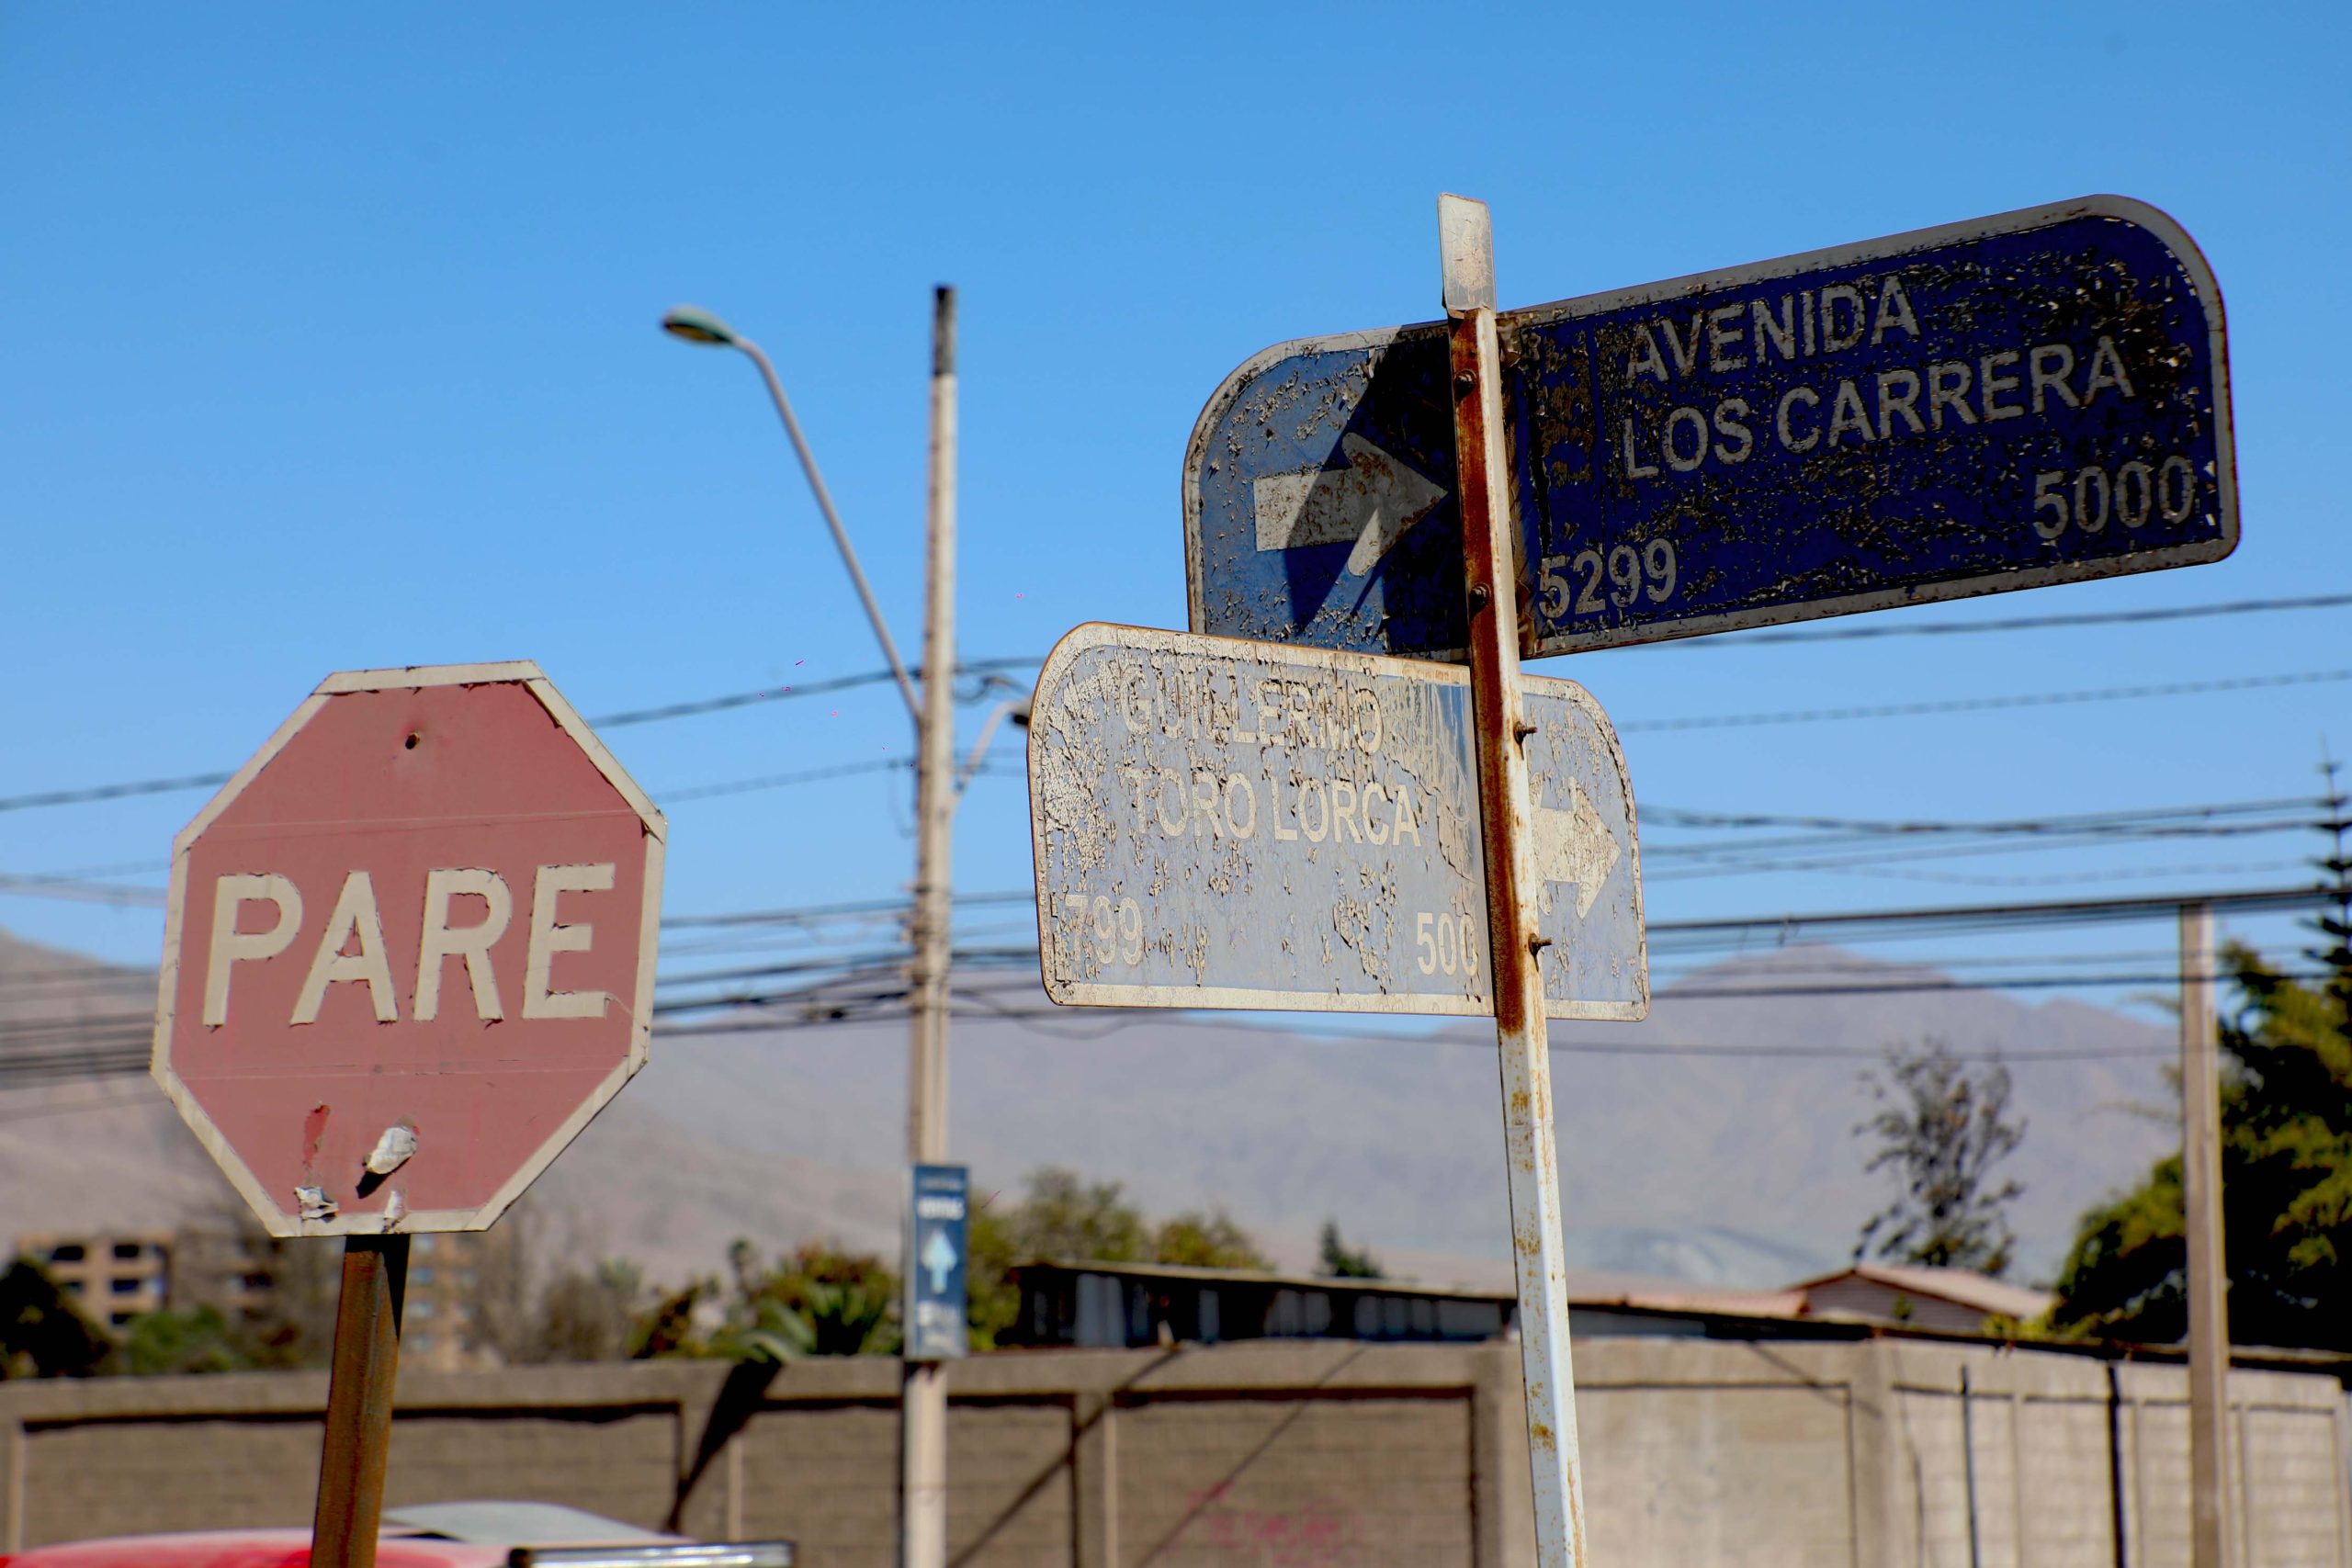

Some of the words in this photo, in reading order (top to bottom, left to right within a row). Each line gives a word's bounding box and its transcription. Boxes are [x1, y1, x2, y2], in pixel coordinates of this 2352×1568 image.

[1627, 275, 1921, 388] AVENIDA
[1624, 398, 1755, 479] LOS
[1777, 336, 2136, 454] CARRERA
[1538, 538, 1678, 619] 5299
[2033, 455, 2197, 540] 5000
[1121, 663, 1384, 754] GUILLERMO
[1123, 765, 1256, 839] TORO
[1269, 779, 1421, 847] LORCA
[201, 863, 616, 1028] PARE
[1064, 895, 1143, 965] 799
[1416, 912, 1479, 976] 500
